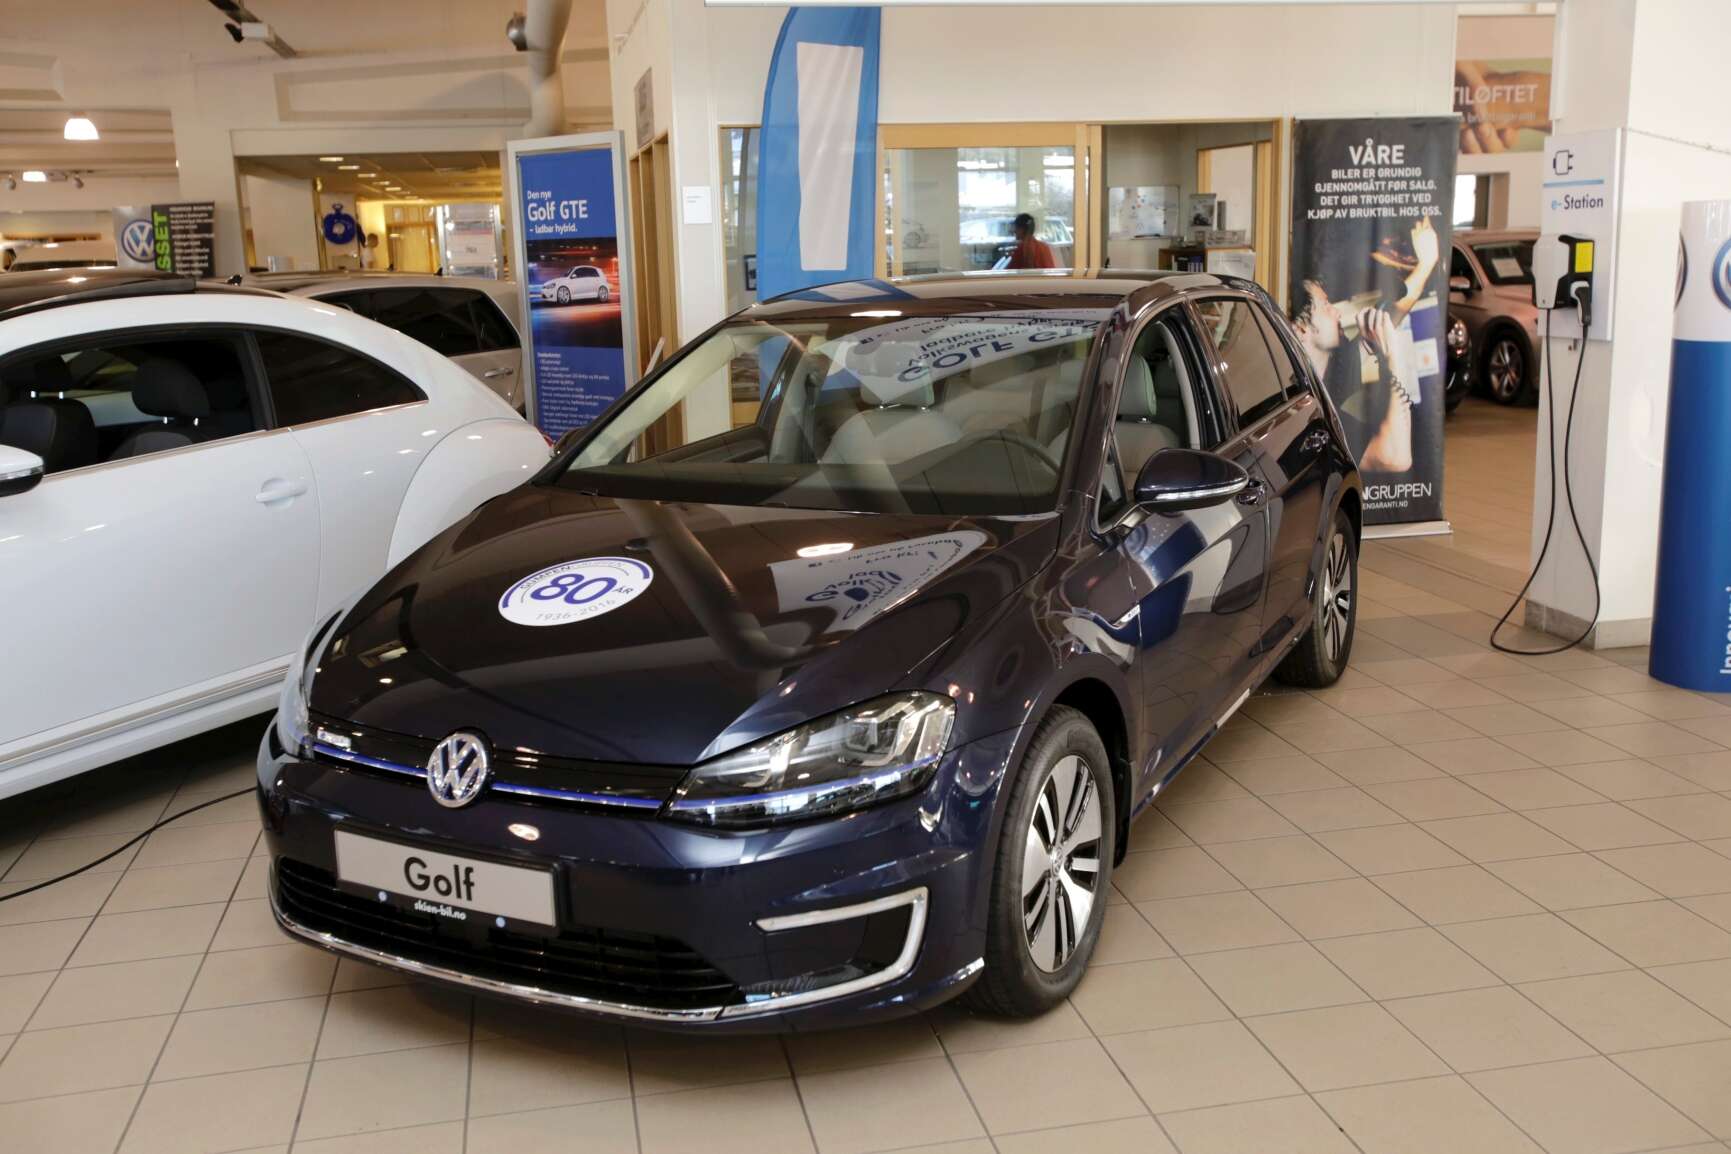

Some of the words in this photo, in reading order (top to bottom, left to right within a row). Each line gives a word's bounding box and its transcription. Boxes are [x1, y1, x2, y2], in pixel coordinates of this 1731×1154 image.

[1349, 138, 1405, 166] VÅRE
[1331, 168, 1361, 179] BILER
[1362, 168, 1376, 178] ER
[1377, 167, 1422, 177] GRUNDIG
[1314, 179, 1387, 193] GJENNOMGÅTT
[1387, 181, 1408, 190] FØR
[1409, 180, 1437, 190] SALG.
[527, 190, 540, 200] Den
[1320, 195, 1340, 206] DET
[1341, 195, 1358, 205] GIR
[1360, 193, 1409, 204] TRYGGHET
[1411, 193, 1432, 203] VED
[527, 201, 556, 221] Golf
[560, 199, 588, 220] GTE
[1307, 208, 1334, 220] KJØP
[1334, 208, 1348, 218] AV
[1349, 207, 1397, 218] BRUKTBIL
[1399, 206, 1420, 217] HOS
[530, 573, 618, 605] 80
[404, 856, 475, 902] Golf
[414, 900, 467, 920] skien-bil.no
